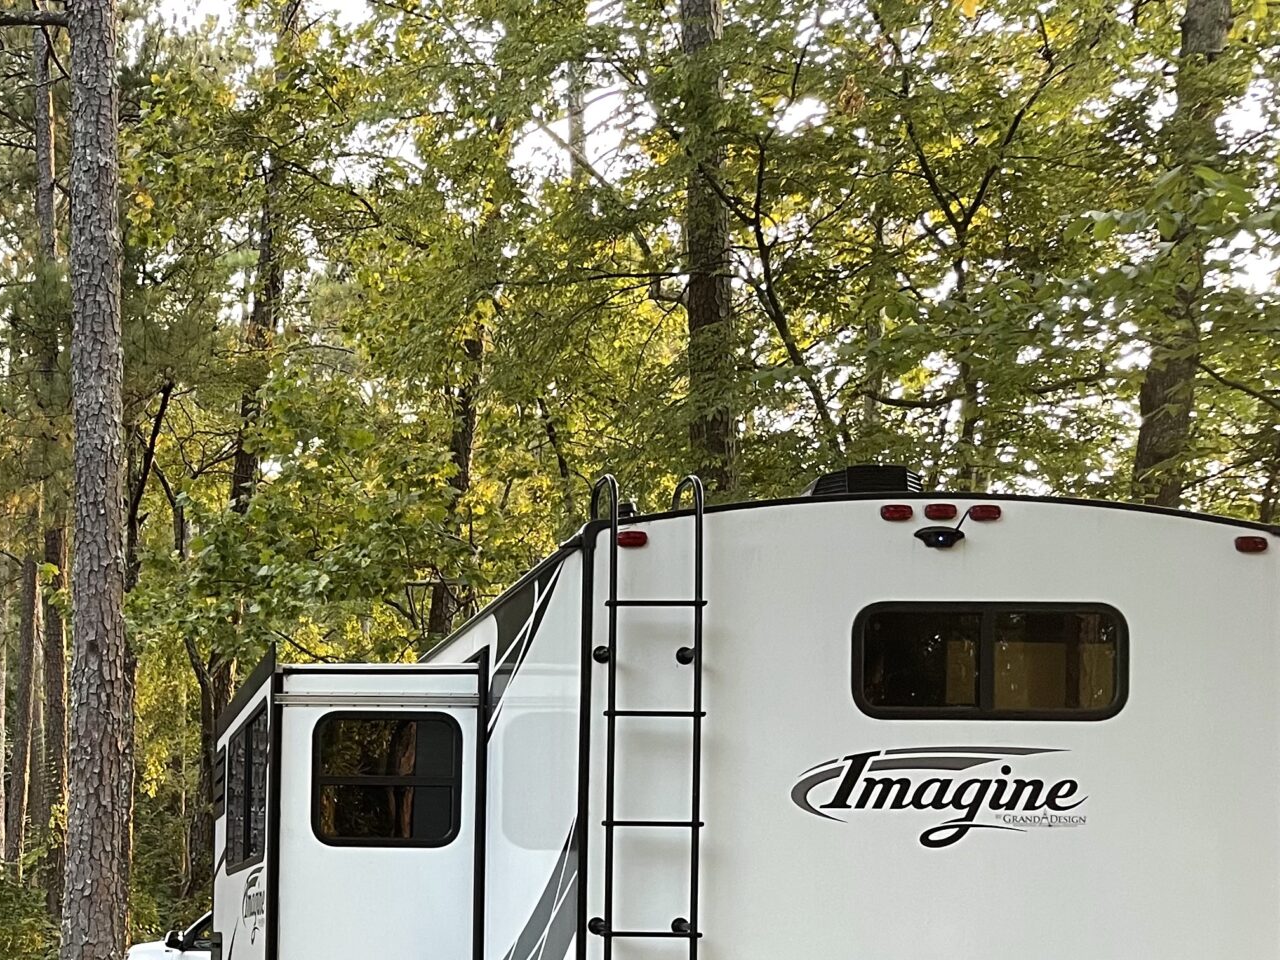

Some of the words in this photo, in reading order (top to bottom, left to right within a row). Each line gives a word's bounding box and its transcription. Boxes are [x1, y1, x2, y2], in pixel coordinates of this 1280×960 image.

[818, 750, 1089, 848] Imagine
[1002, 813, 1042, 824] GRAND
[1049, 813, 1087, 824] DESIGN
